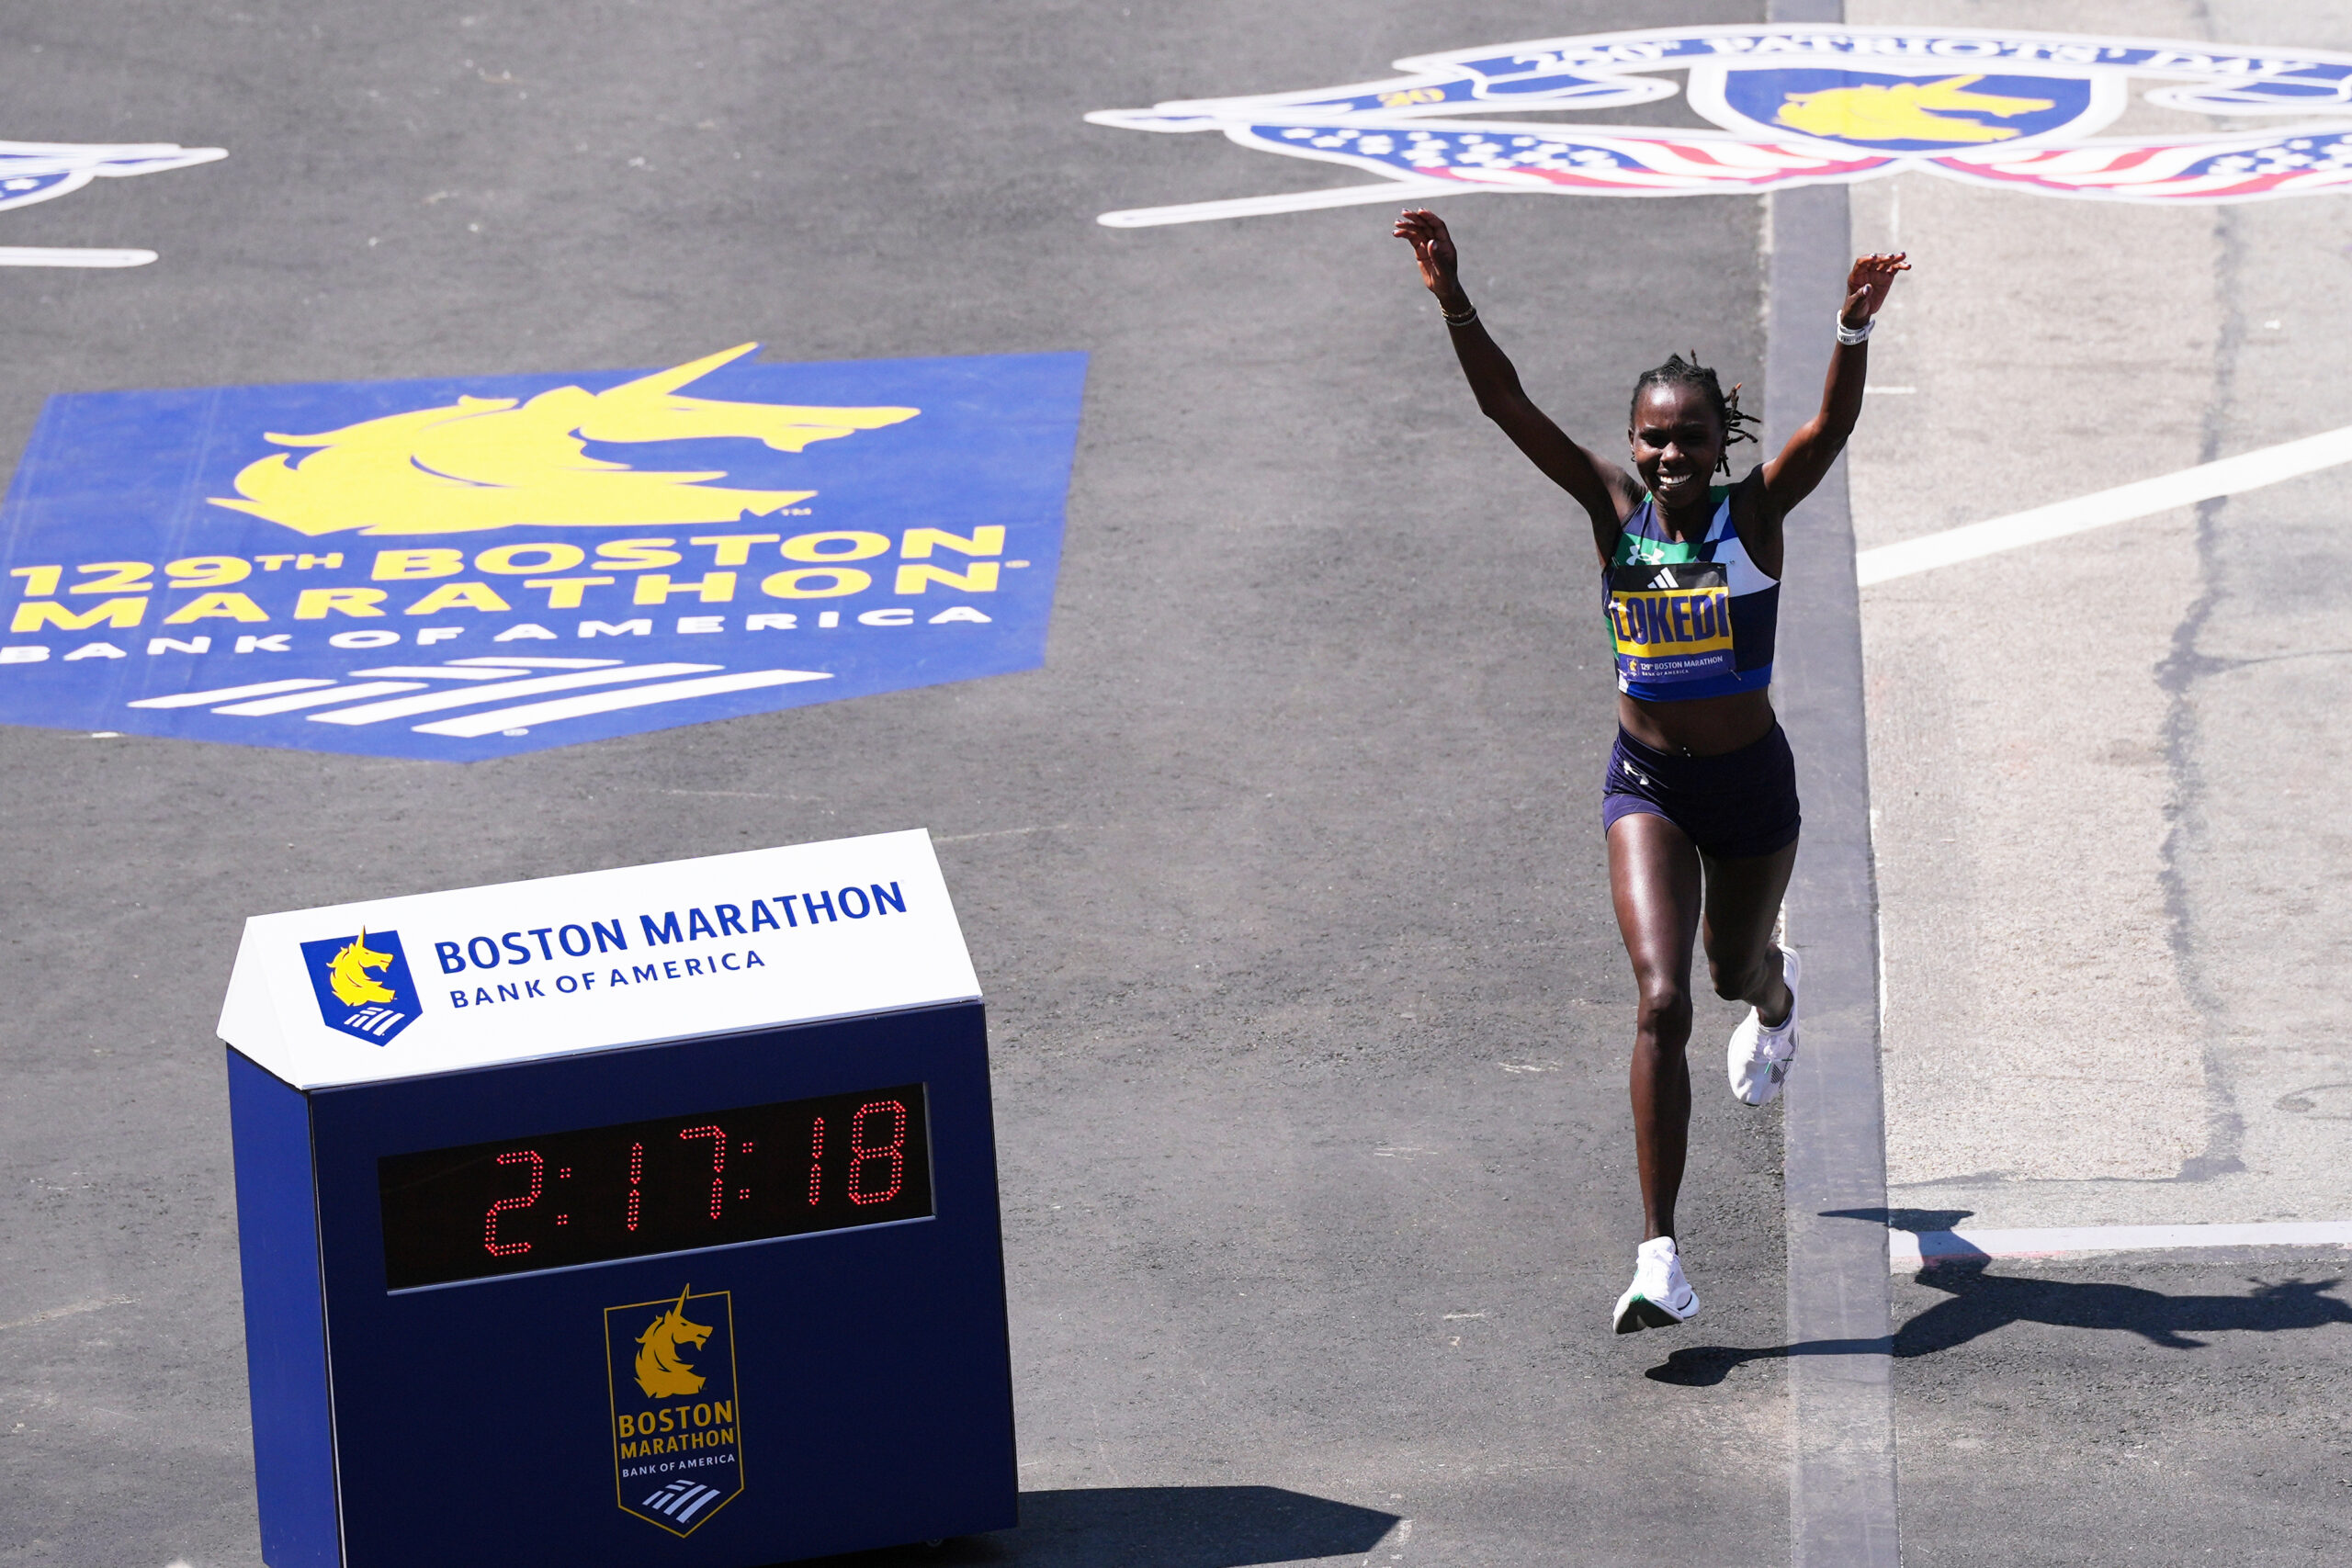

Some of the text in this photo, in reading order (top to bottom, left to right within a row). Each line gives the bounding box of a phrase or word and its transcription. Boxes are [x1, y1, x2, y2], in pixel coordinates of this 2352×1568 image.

[370, 525, 1005, 581] BOSTON
[10, 561, 1000, 632] MARATHON
[1612, 593, 1730, 645] LOKEDI
[0, 606, 992, 663] BANK OF AMERICA
[1655, 660, 1682, 671] BOSTON
[1683, 655, 1724, 669] MARATHON
[435, 881, 907, 975] BOSTON MARATHON
[449, 950, 765, 1009] BANK OF AMERICA
[484, 1100, 907, 1257] 2:17:18
[618, 1400, 733, 1438] BOSTON
[620, 1427, 735, 1460] MARATHON
[622, 1453, 736, 1478] BANK OF AMERICA
